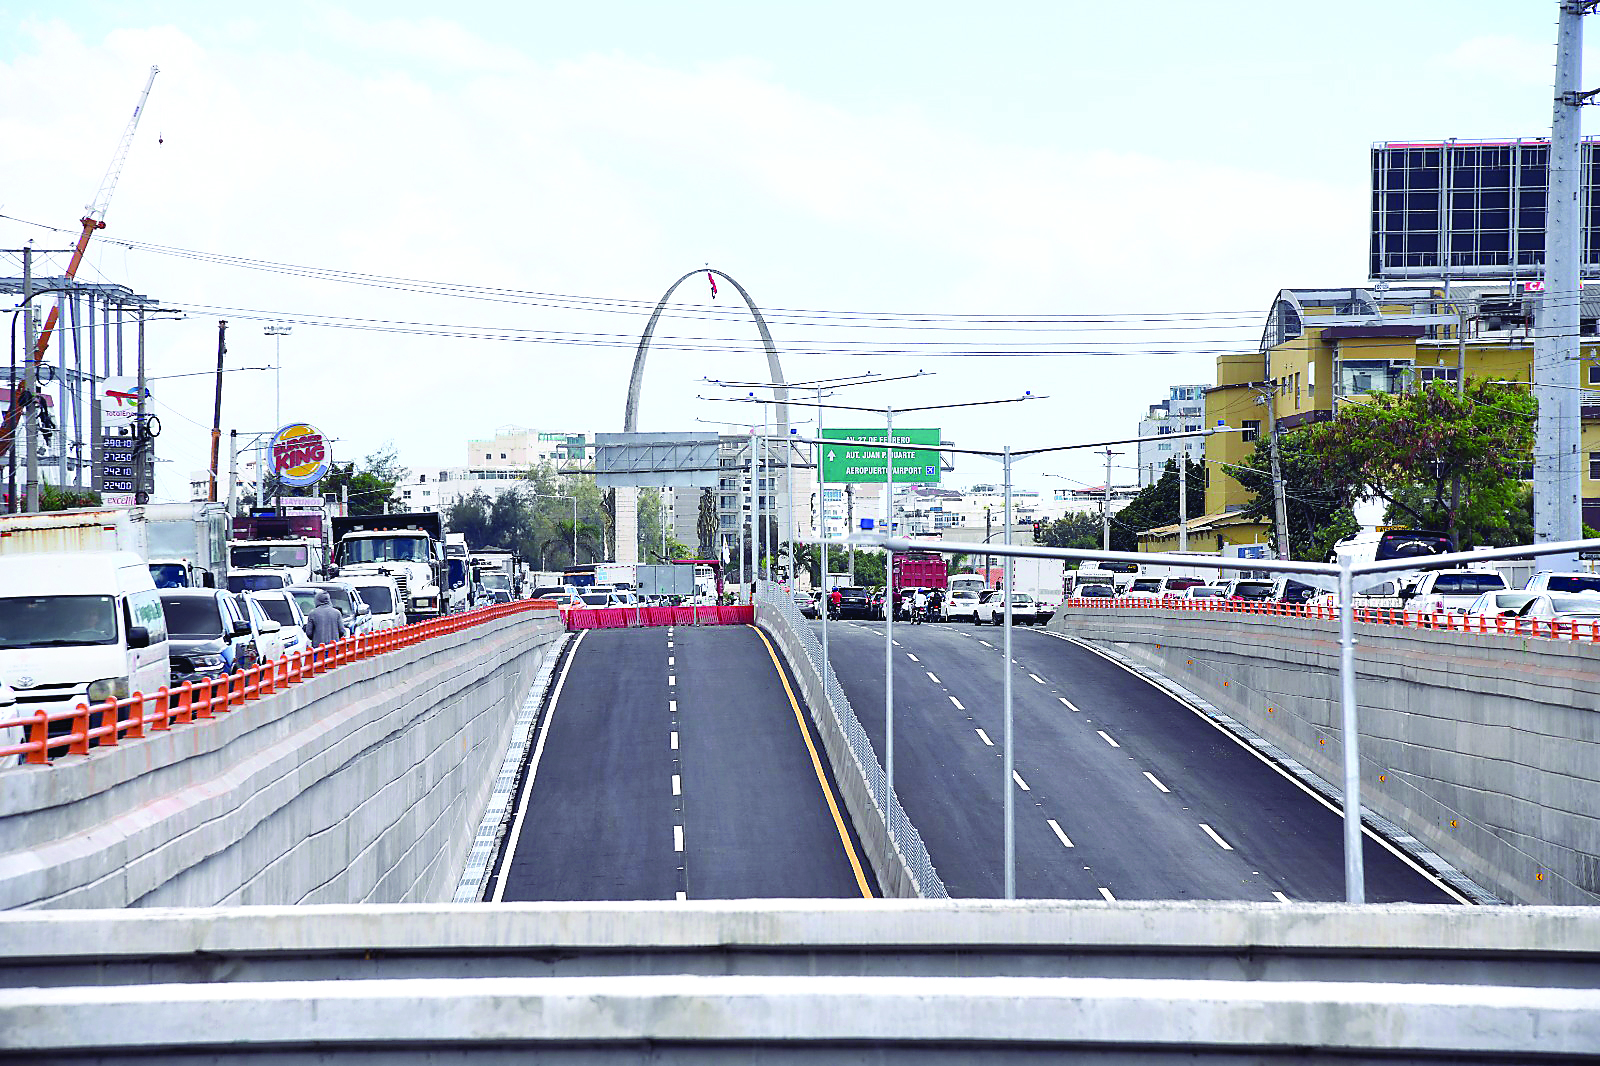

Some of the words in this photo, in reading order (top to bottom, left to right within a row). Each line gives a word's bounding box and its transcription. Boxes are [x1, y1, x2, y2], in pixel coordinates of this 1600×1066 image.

[274, 435, 322, 456] BURGER
[879, 436, 911, 444] FERERO
[275, 445, 325, 471] KING
